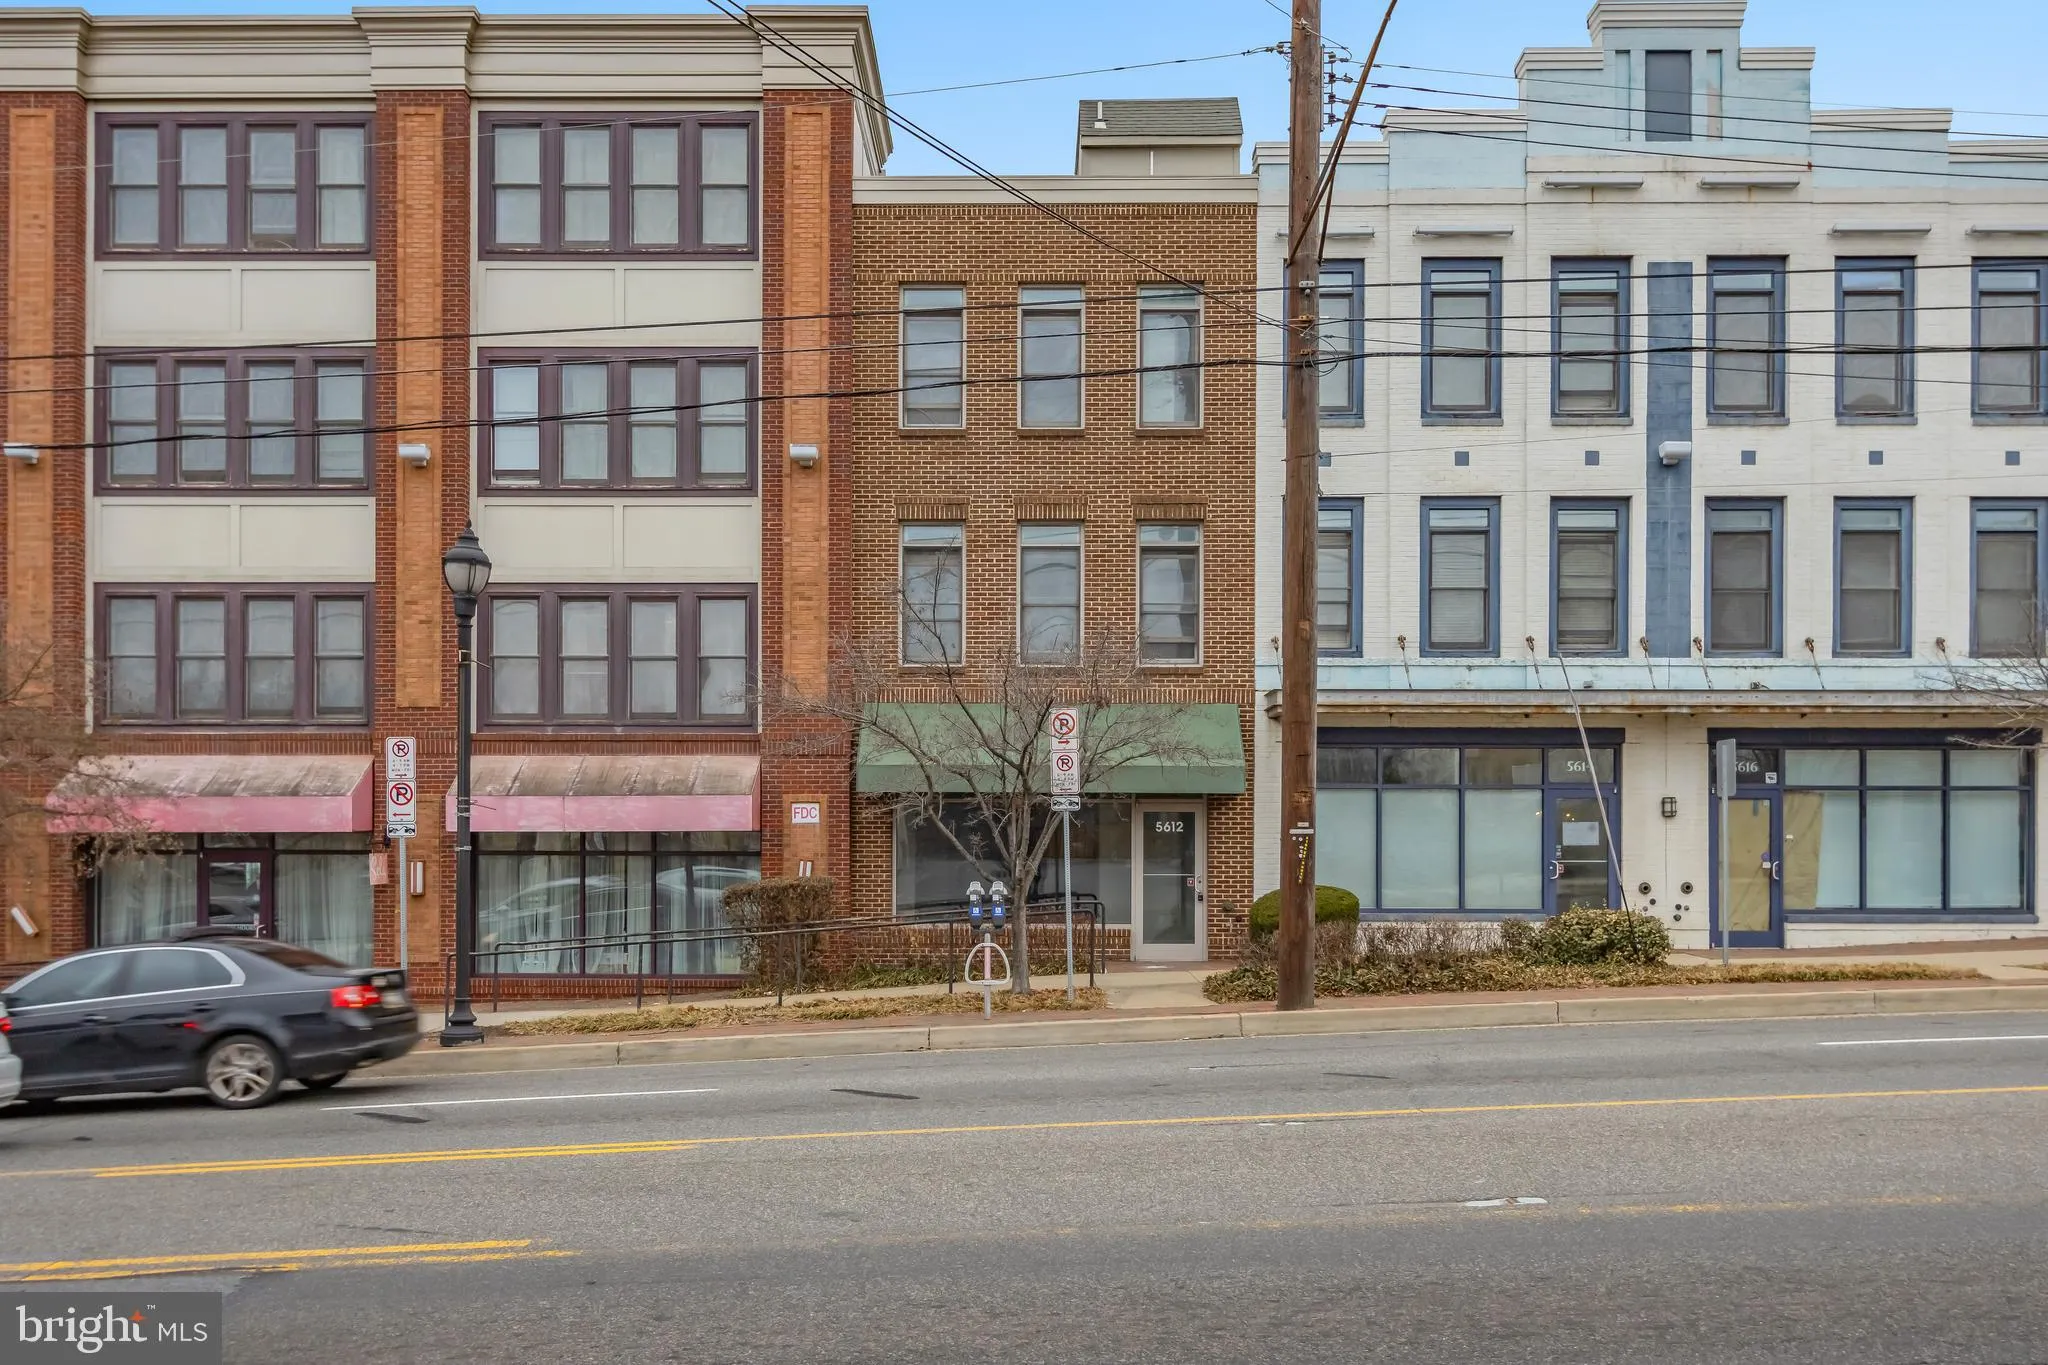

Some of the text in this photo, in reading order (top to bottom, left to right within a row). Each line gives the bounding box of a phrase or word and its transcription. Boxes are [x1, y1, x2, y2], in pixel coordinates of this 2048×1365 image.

[1567, 760, 1591, 772] 561
[793, 806, 818, 819] FDC
[1155, 821, 1184, 833] 5612
